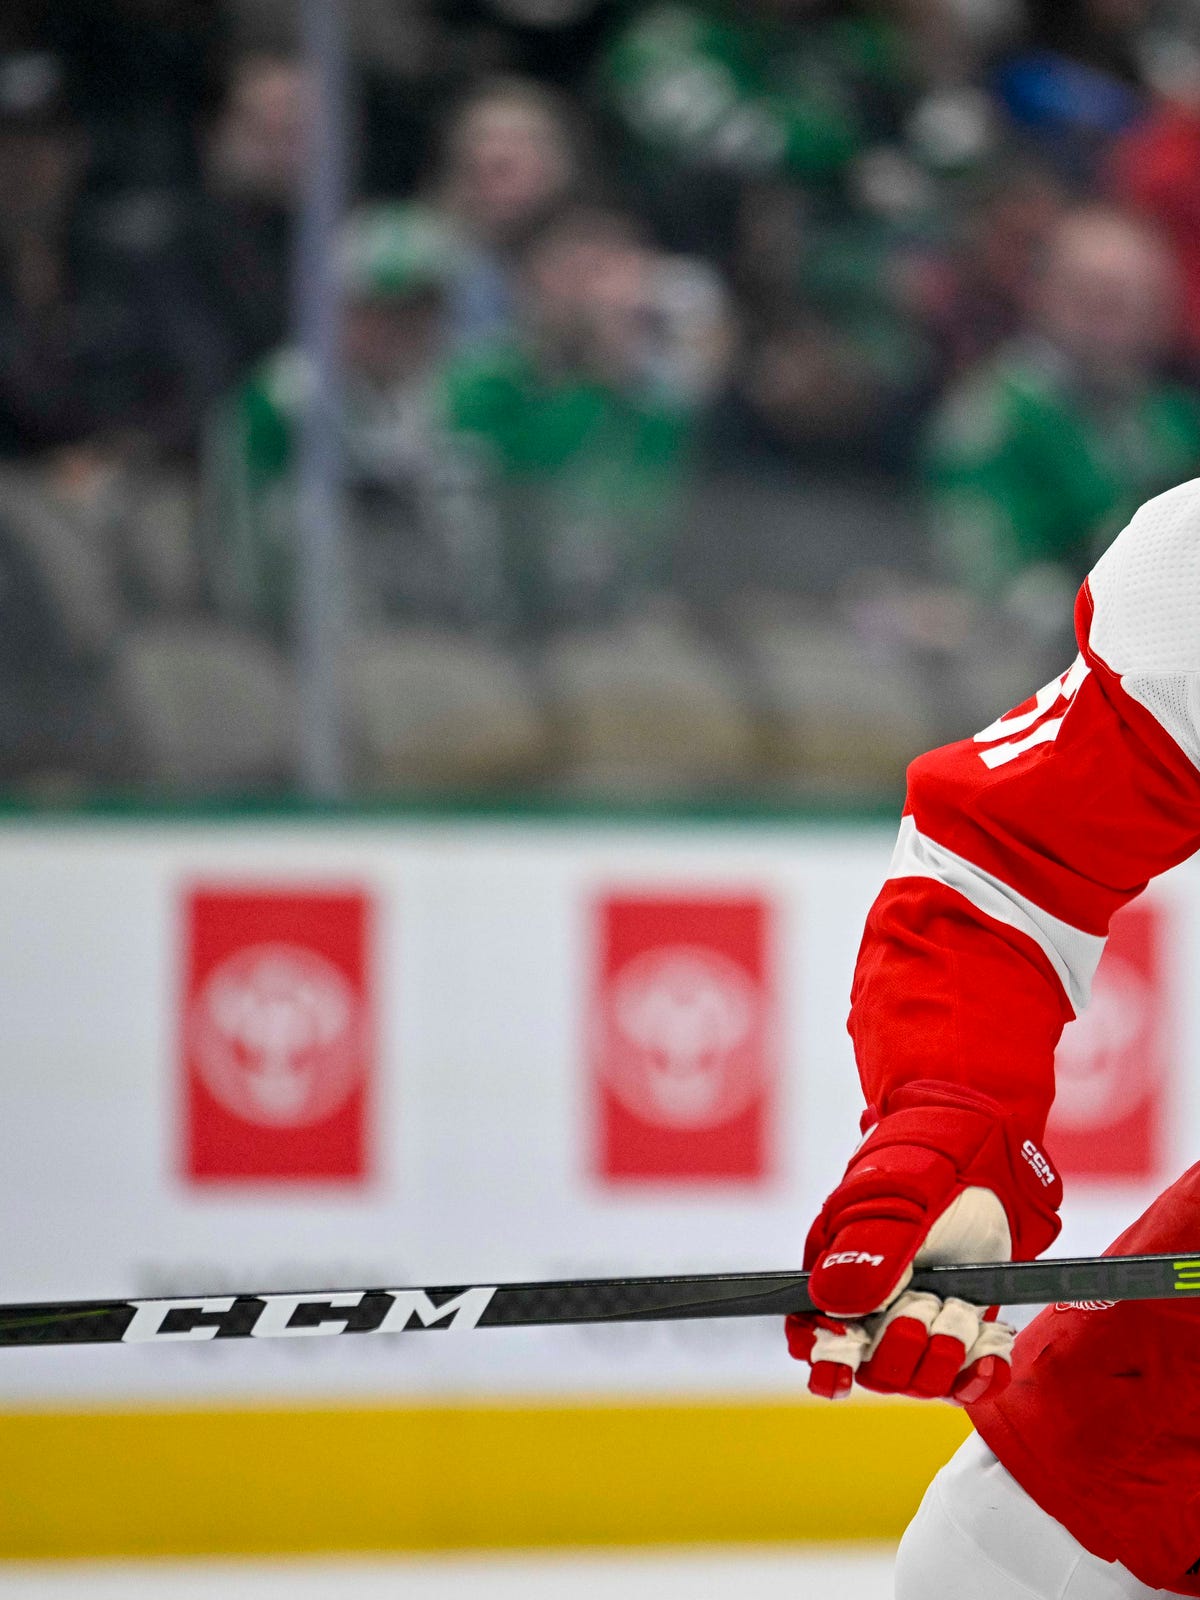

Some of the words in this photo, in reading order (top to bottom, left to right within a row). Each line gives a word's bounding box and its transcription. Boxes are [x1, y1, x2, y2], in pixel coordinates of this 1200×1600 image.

[1022, 1139, 1055, 1184] CCM
[822, 1250, 884, 1269] CCM
[120, 1286, 498, 1344] CCM
